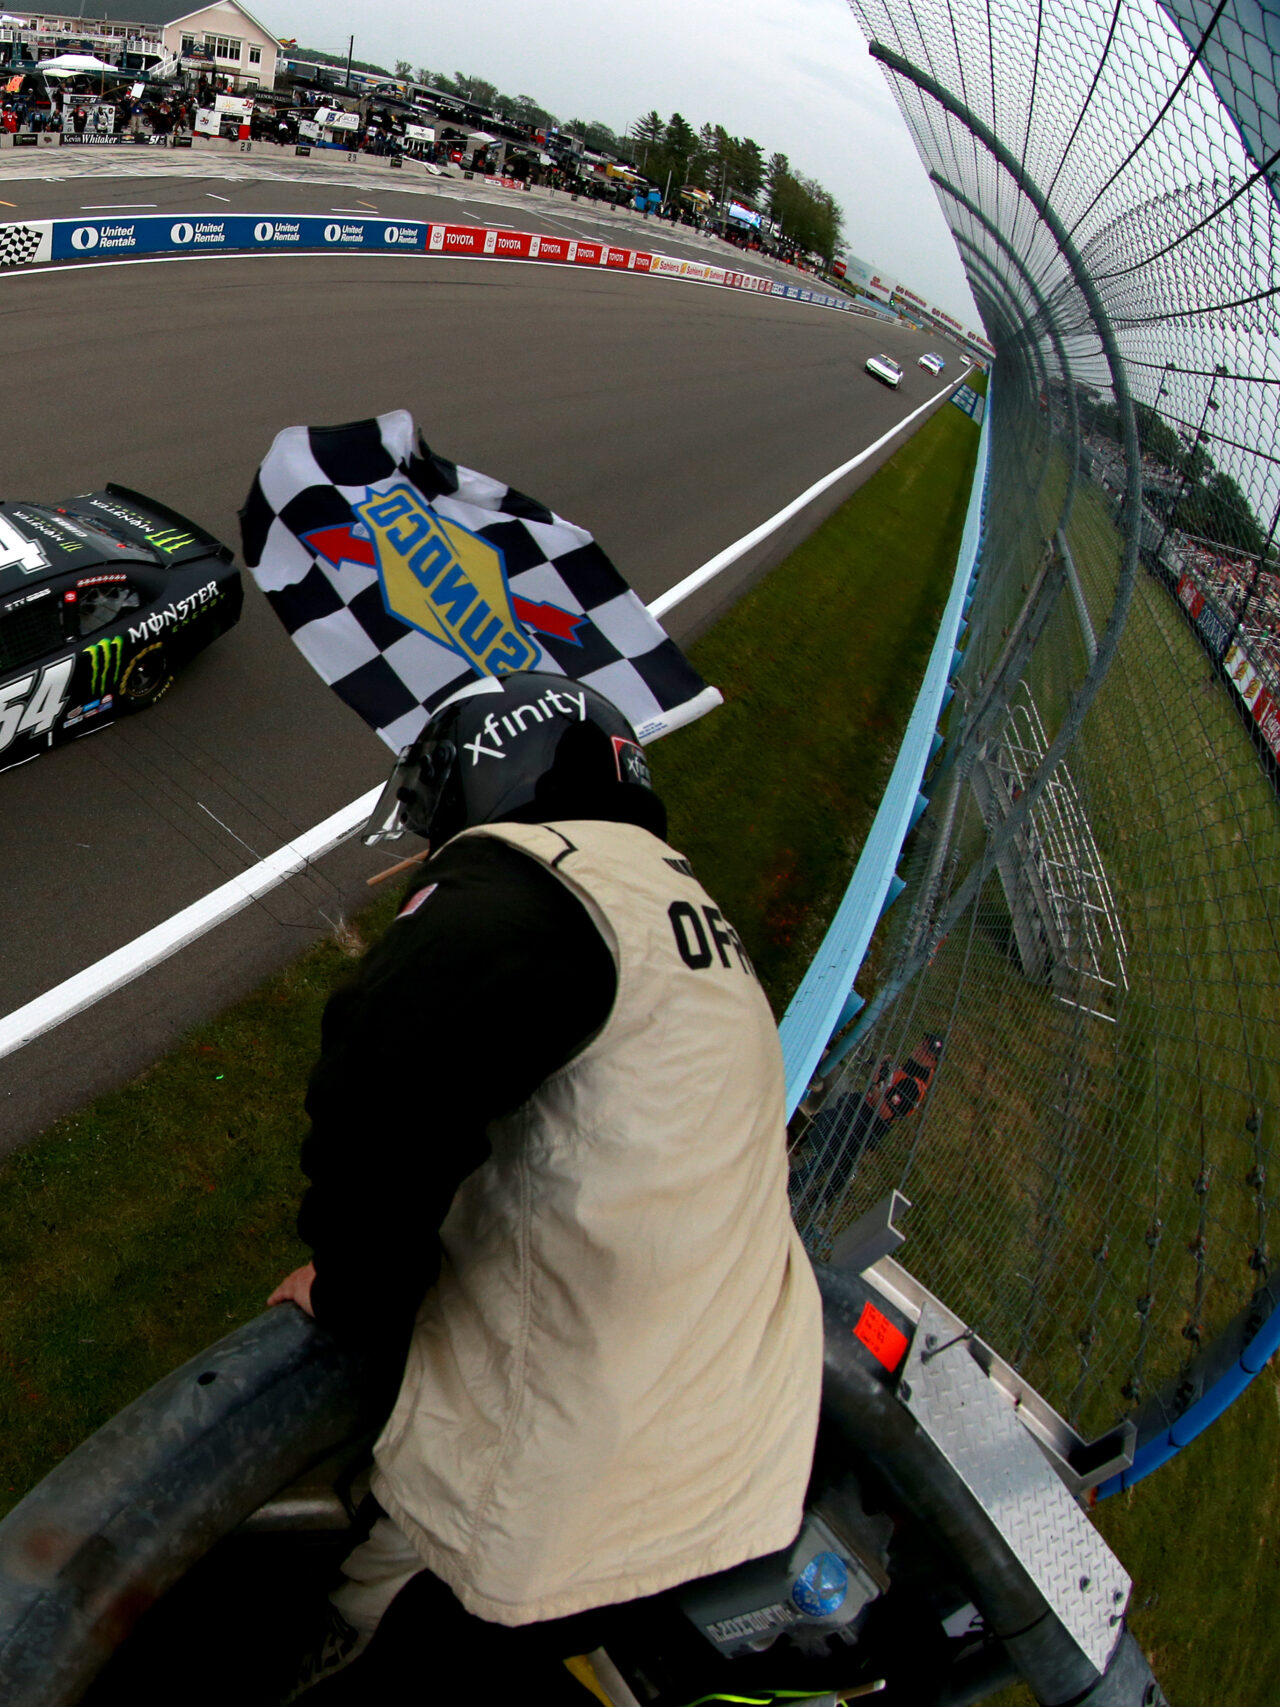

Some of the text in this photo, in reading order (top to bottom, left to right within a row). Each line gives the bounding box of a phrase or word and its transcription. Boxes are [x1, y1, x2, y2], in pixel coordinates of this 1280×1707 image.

[63, 133, 119, 145] Kevin Whitaker
[101, 225, 135, 237] United
[195, 222, 225, 234] United
[274, 222, 301, 232] United
[342, 224, 365, 235] United
[399, 227, 419, 236] United
[99, 235, 137, 248] Rentals
[193, 231, 226, 243] Rentals
[273, 231, 301, 242] Rentals
[340, 233, 365, 244] Rentals
[397, 235, 419, 244] Rentals
[446, 232, 474, 246] TOYOTA
[498, 237, 521, 250] TOYOTA
[541, 242, 561, 255] TOYOTA
[577, 248, 595, 259] TOYOTA
[608, 252, 624, 263] TOYOTA
[462, 687, 587, 767] xfinity
